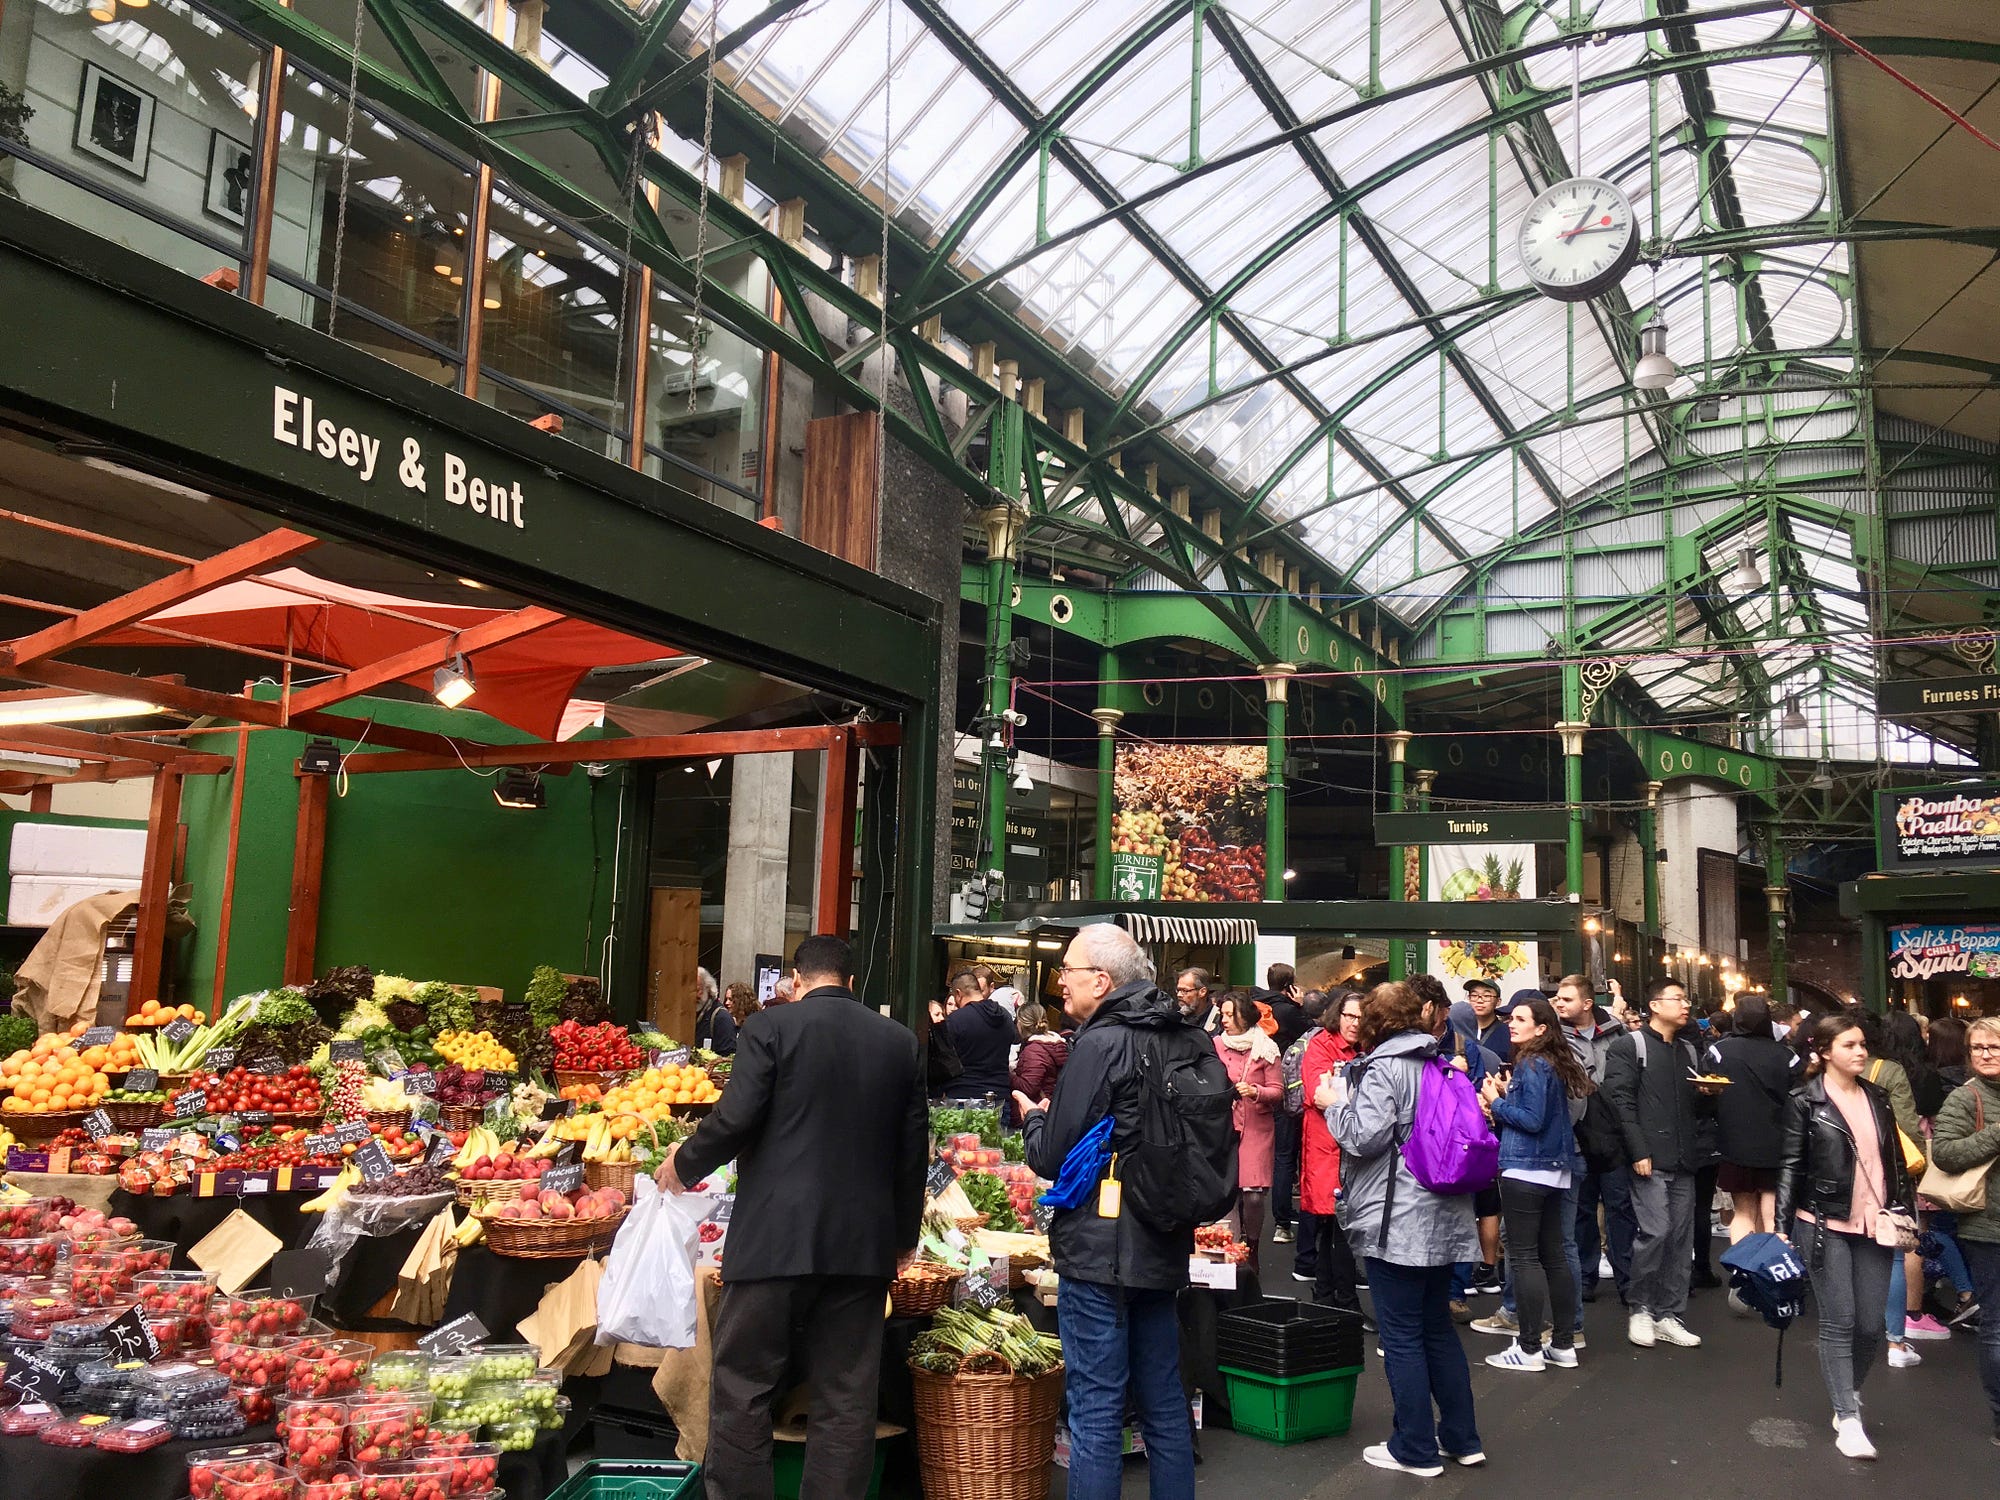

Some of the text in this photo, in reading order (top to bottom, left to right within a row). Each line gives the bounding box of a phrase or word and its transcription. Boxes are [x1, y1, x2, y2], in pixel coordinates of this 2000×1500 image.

[274, 385, 524, 529] Elsey & Bent
[1922, 688, 1979, 704] Furness
[1908, 794, 1982, 817] Bomba
[1021, 826, 1037, 839] way
[1447, 820, 1489, 835] Turnips
[1909, 814, 1973, 835] Paella
[1898, 929, 2000, 955] Salt & Pepper
[1891, 950, 1971, 980] Squid
[547, 1166, 580, 1178] PEACHES
[133, 1303, 161, 1360] BLUEBERRY
[14, 1346, 66, 1384] RASPBERRY
